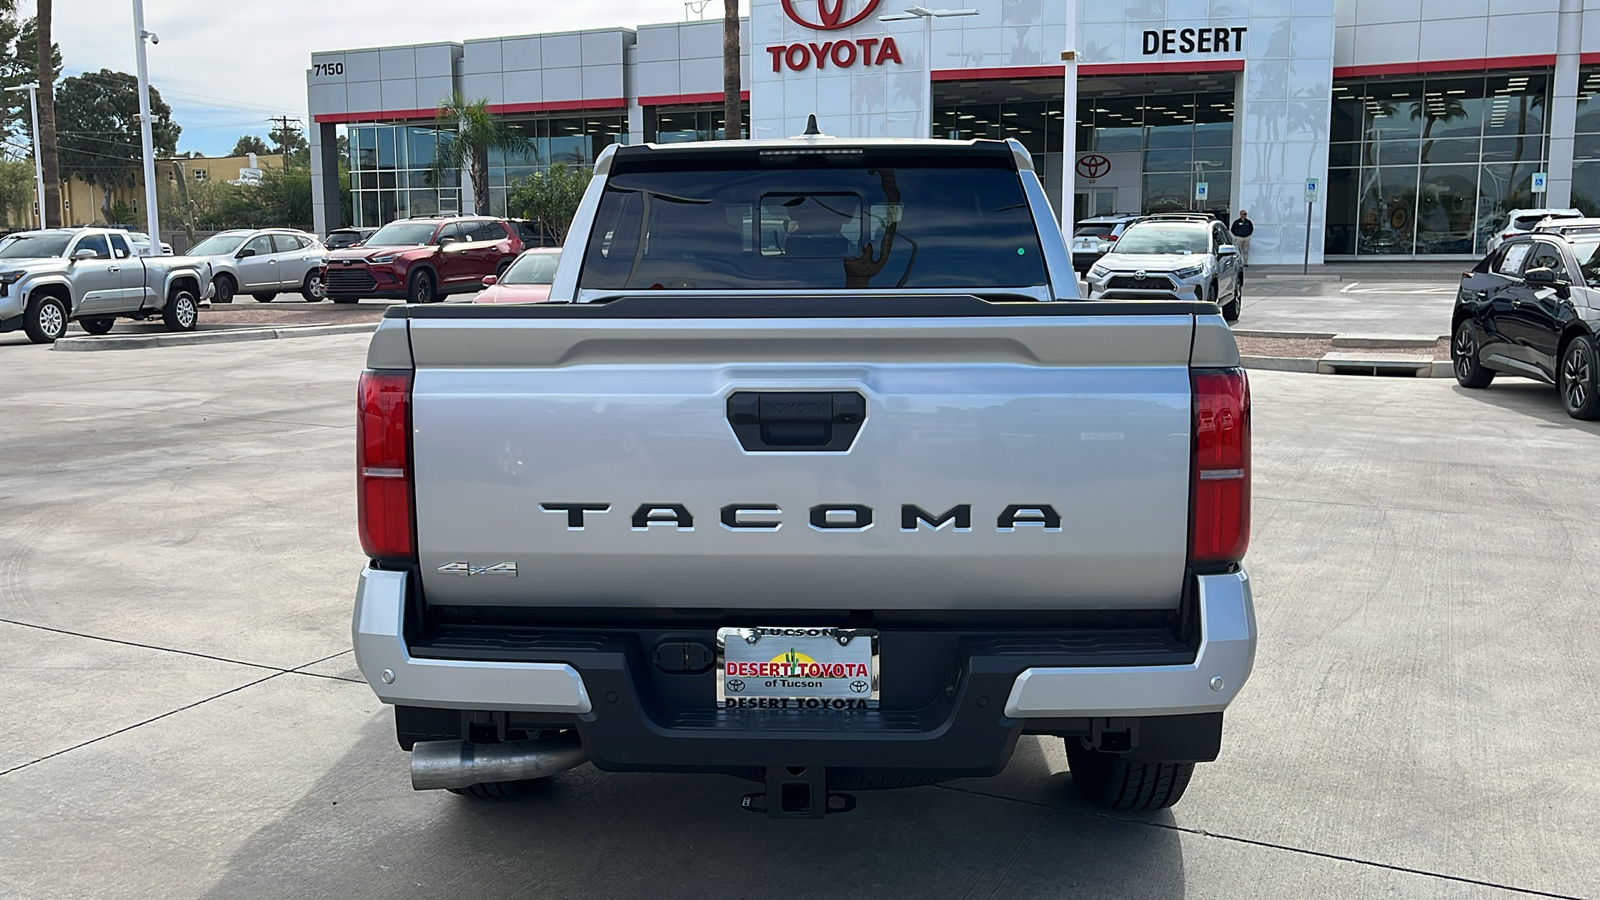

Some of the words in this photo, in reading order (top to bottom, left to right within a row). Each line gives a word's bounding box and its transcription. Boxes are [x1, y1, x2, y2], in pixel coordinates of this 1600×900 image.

[1142, 27, 1248, 55] DESERT
[766, 37, 902, 73] TOYOTA
[313, 62, 344, 77] 7150
[762, 402, 830, 414] TOYOTA
[538, 502, 1062, 533] TACOMA
[437, 560, 519, 578] 4x4
[759, 628, 837, 637] TUCSON
[726, 662, 792, 677] DESERT
[798, 663, 868, 678] TOYOTA
[764, 679, 778, 688] of
[780, 679, 823, 688] Tucson
[725, 698, 788, 709] DESERT
[799, 698, 869, 709] TOYOTA
